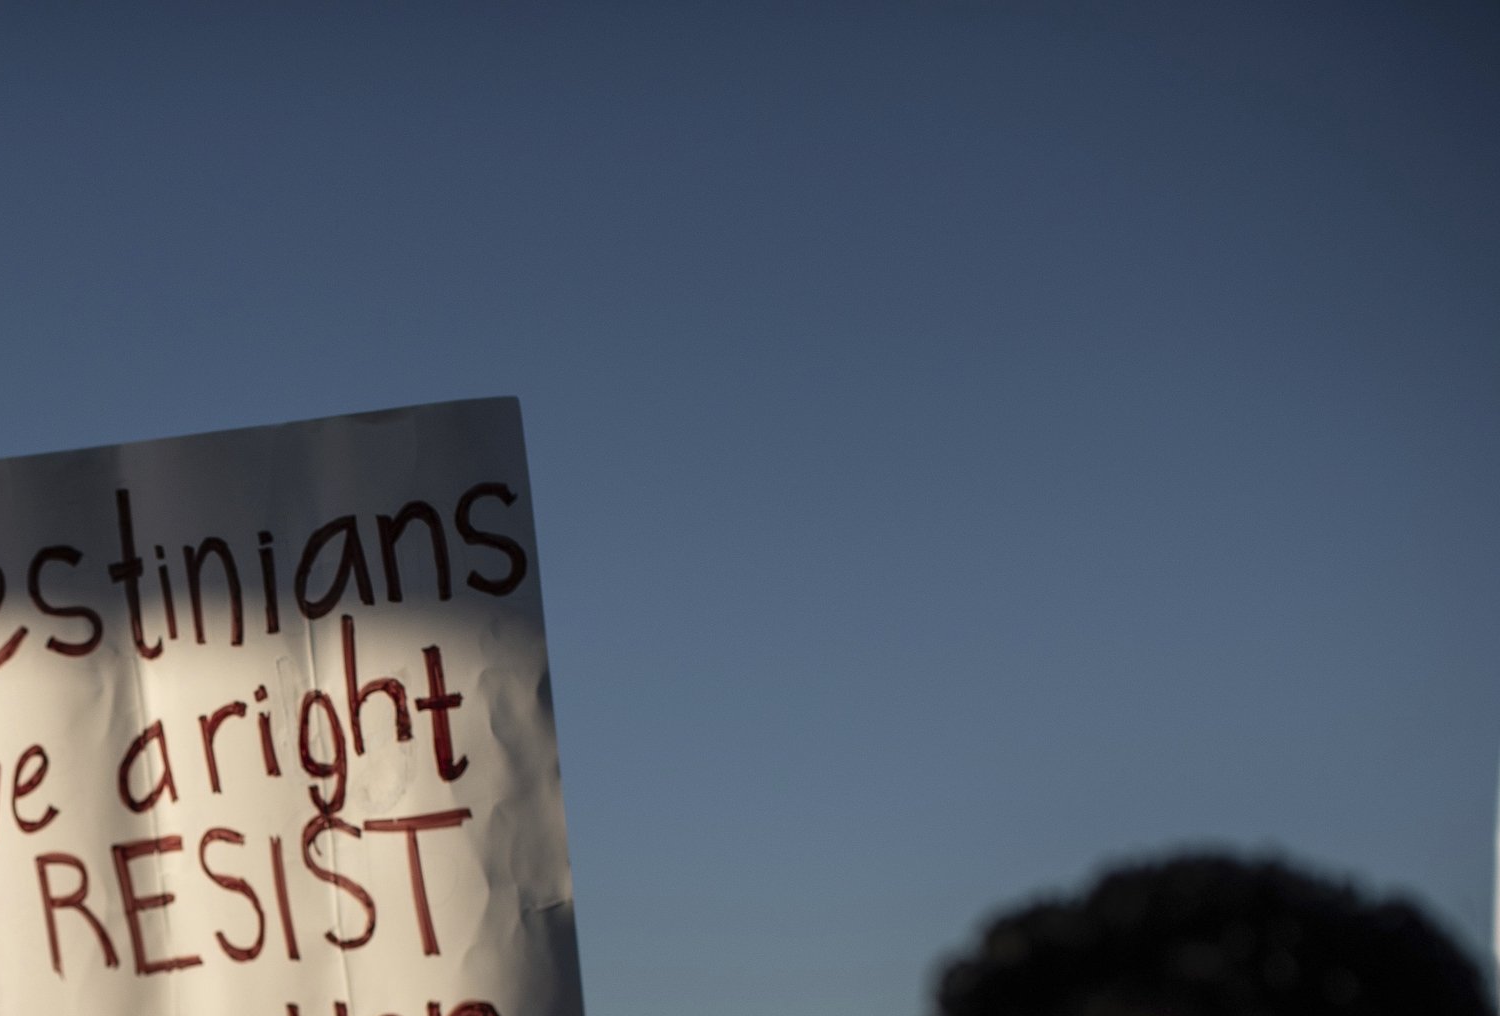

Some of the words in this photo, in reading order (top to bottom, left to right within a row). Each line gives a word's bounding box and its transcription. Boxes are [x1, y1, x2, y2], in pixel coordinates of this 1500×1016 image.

[119, 720, 178, 813] a
[198, 615, 468, 815] right
[36, 809, 472, 979] RESIST
